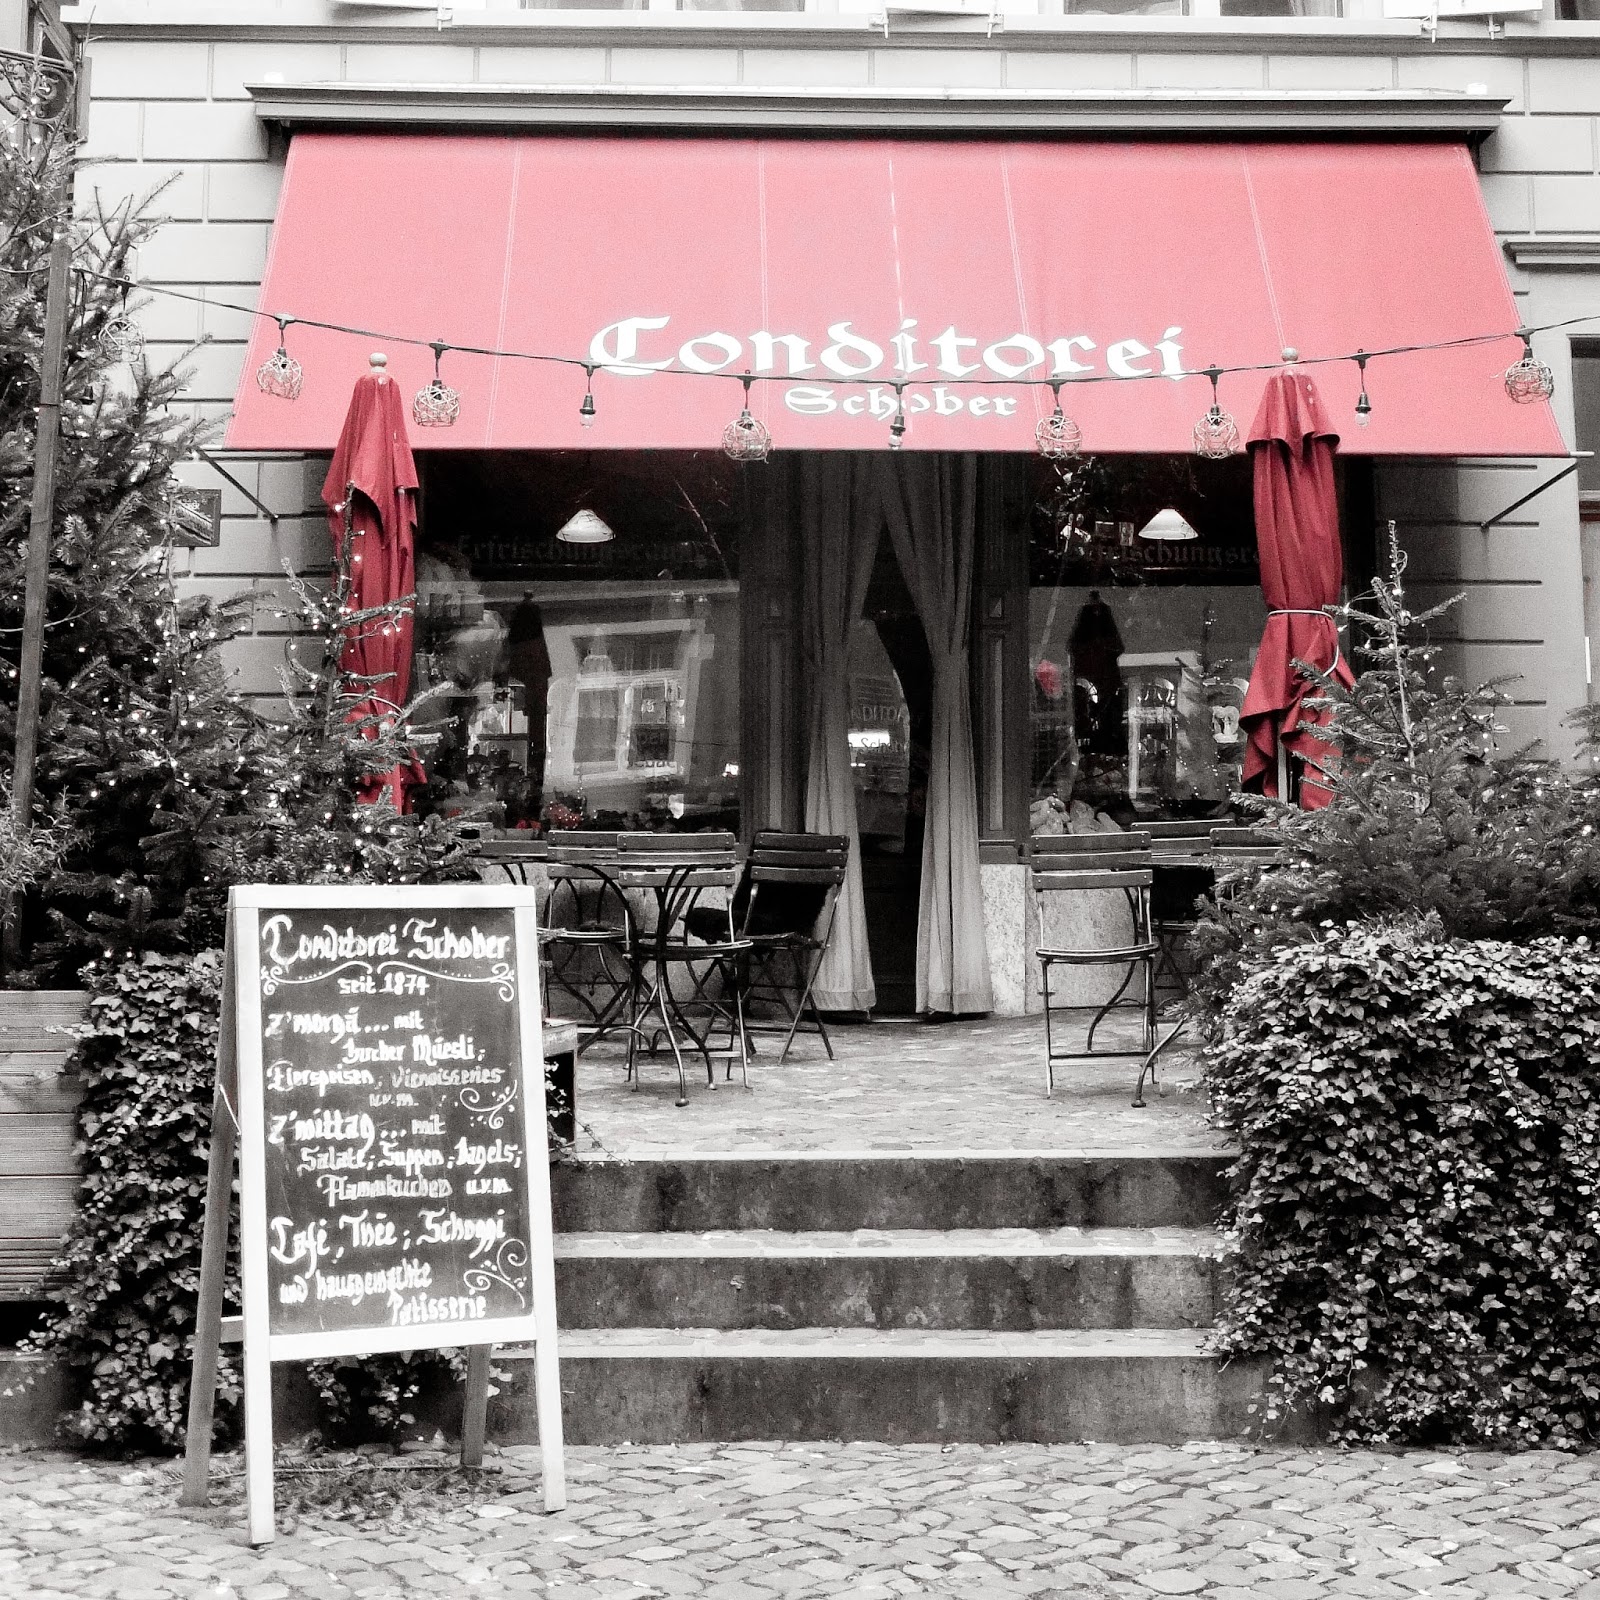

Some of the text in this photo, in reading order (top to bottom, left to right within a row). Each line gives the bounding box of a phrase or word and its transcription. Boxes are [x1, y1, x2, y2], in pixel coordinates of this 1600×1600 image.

[589, 315, 1194, 381] Conditorei
[785, 386, 1018, 421] Schober
[261, 914, 509, 972] Conditorei Schober
[337, 971, 430, 995] seit 1874
[393, 1010, 425, 1030] mit
[411, 1113, 447, 1135] mit
[416, 1207, 506, 1259] Schoggi
[280, 1257, 432, 1306] und hausgemachte
